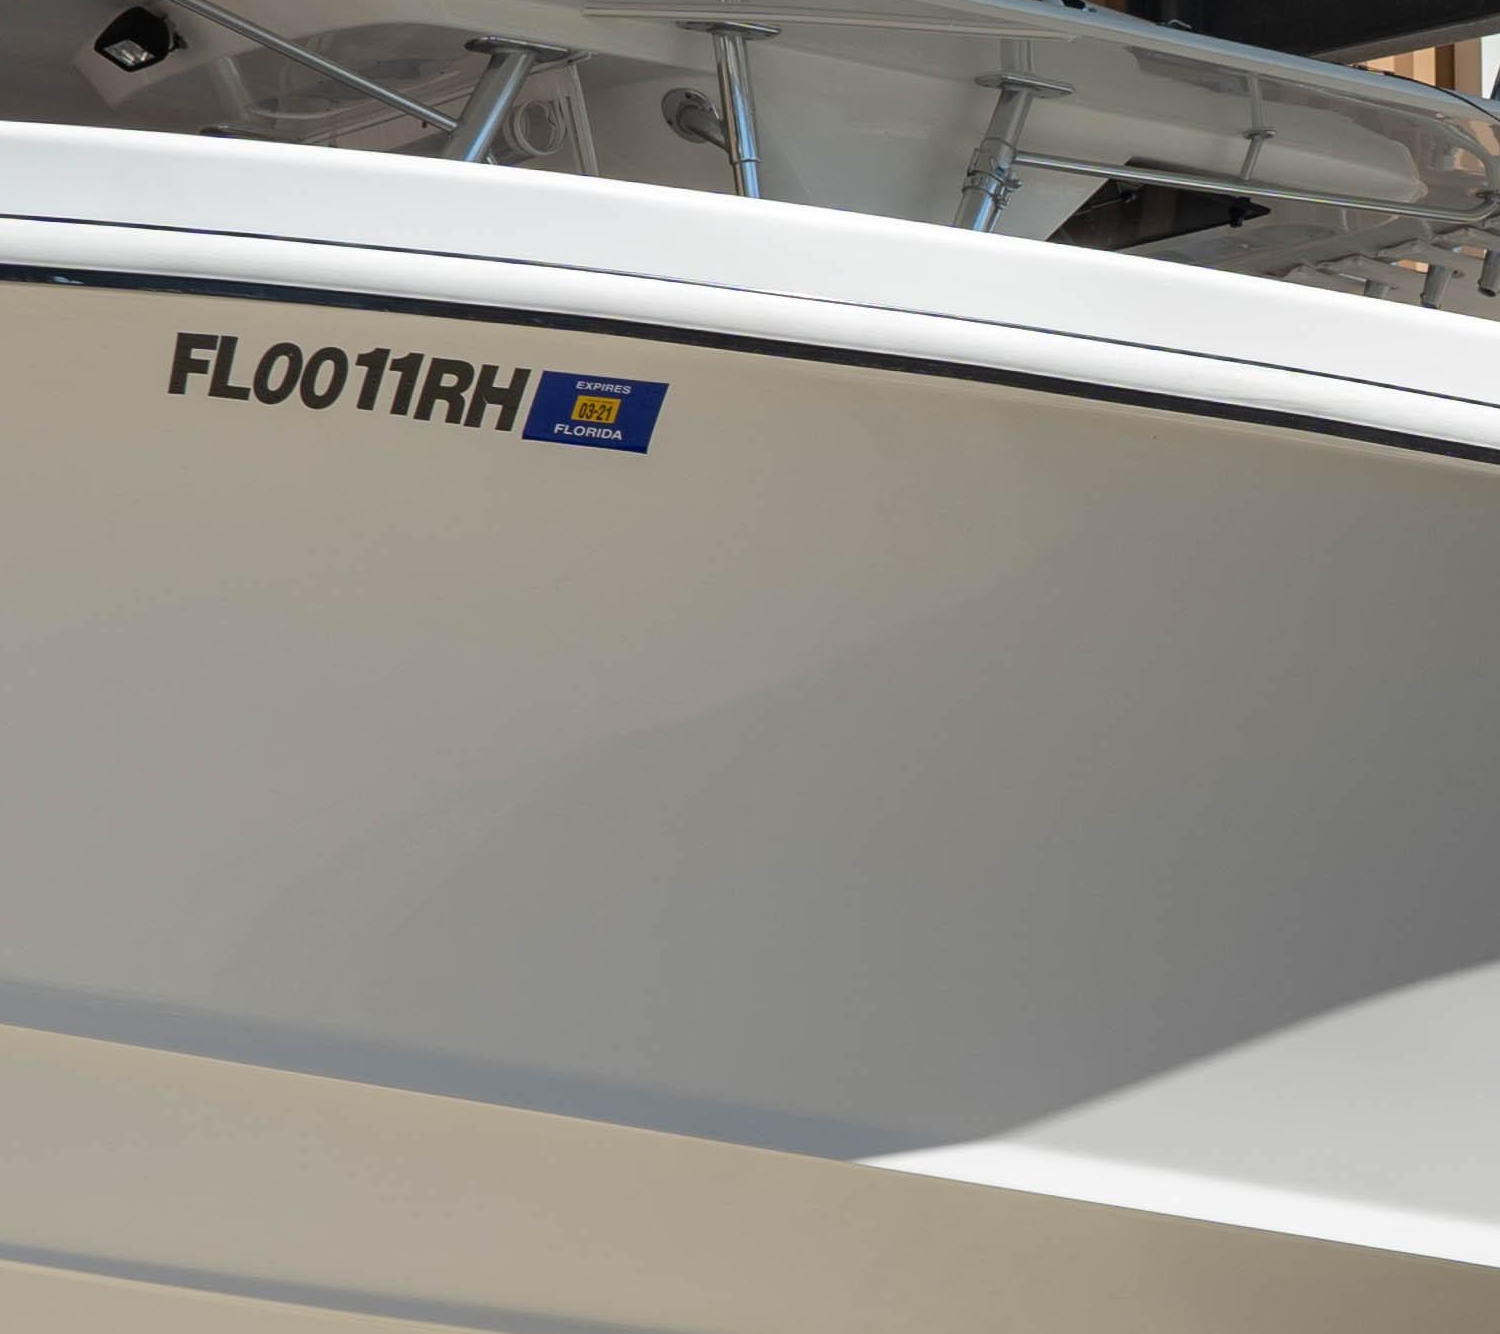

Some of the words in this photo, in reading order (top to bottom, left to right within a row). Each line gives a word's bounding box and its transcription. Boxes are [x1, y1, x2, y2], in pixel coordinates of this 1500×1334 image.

[167, 332, 531, 432] FL0011RH
[575, 381, 632, 394] EXPIRES
[578, 402, 613, 421] 03-21
[554, 423, 622, 440] FLORIDA
